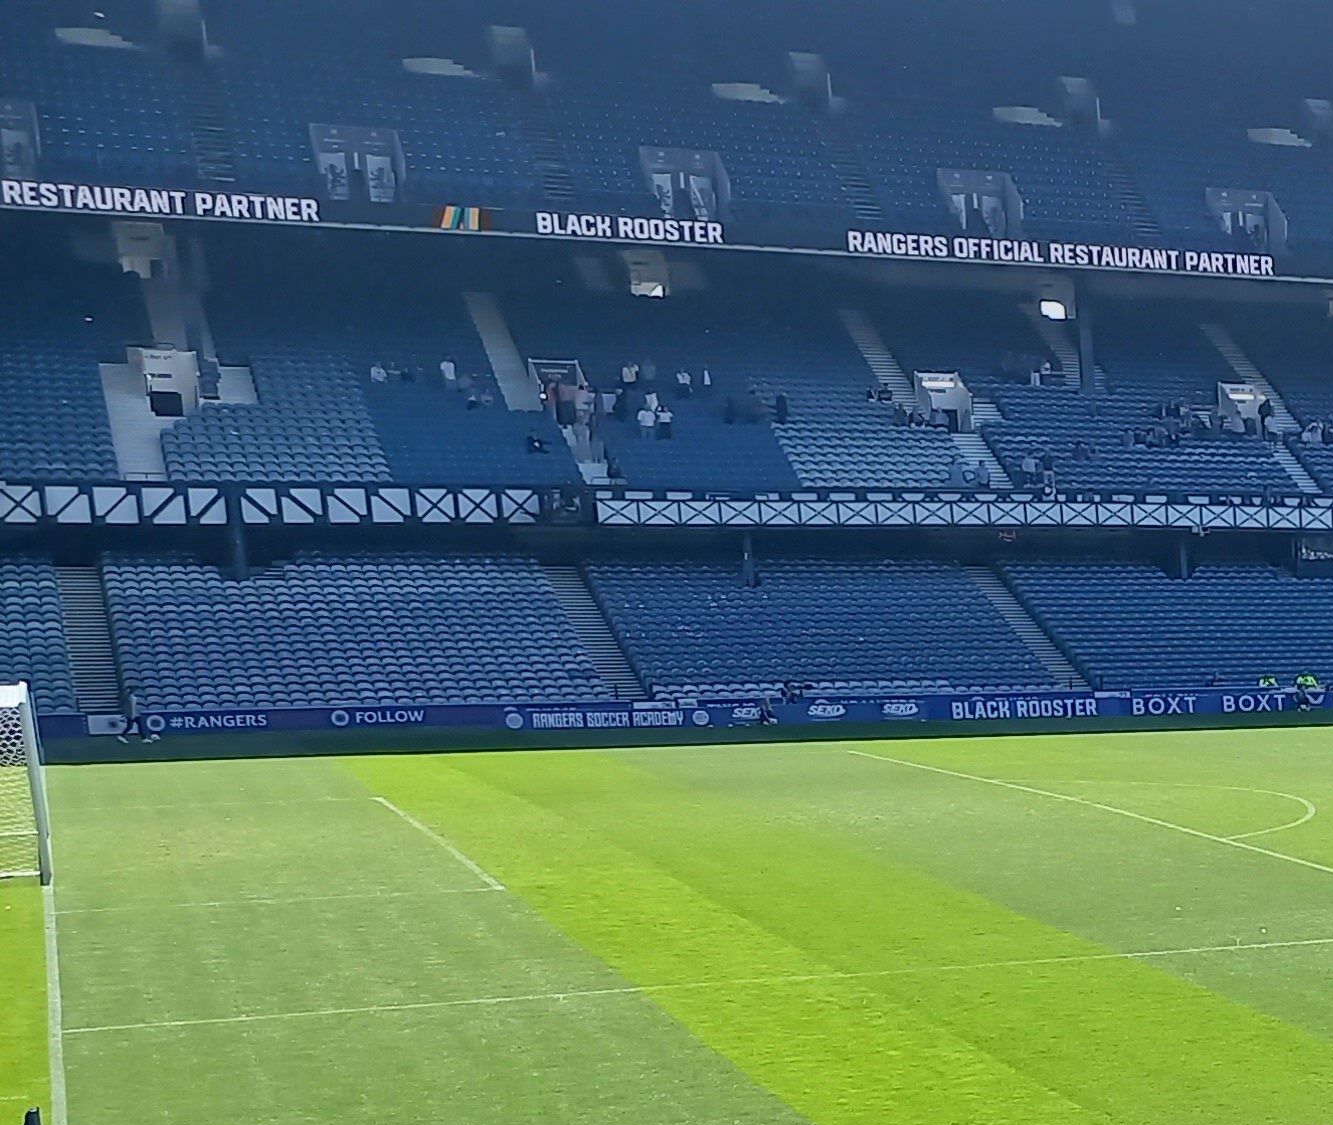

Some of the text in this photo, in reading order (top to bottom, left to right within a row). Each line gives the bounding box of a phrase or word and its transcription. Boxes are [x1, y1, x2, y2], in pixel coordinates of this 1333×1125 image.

[2, 180, 320, 223] RESTAURANT PARTNER
[536, 211, 724, 244] BLACK ROOSTER
[847, 230, 1274, 276] RANGERS OFFICIAL RESTAURANT PARTNER
[732, 706, 761, 718] SEK
[951, 699, 1098, 721] BLACK ROOSTER
[1132, 697, 1196, 716] BOXT
[1222, 694, 1286, 713] BOXT
[170, 712, 267, 729] #RANGERS
[355, 709, 424, 724] FOLLOW
[532, 711, 583, 728] RANGERS
